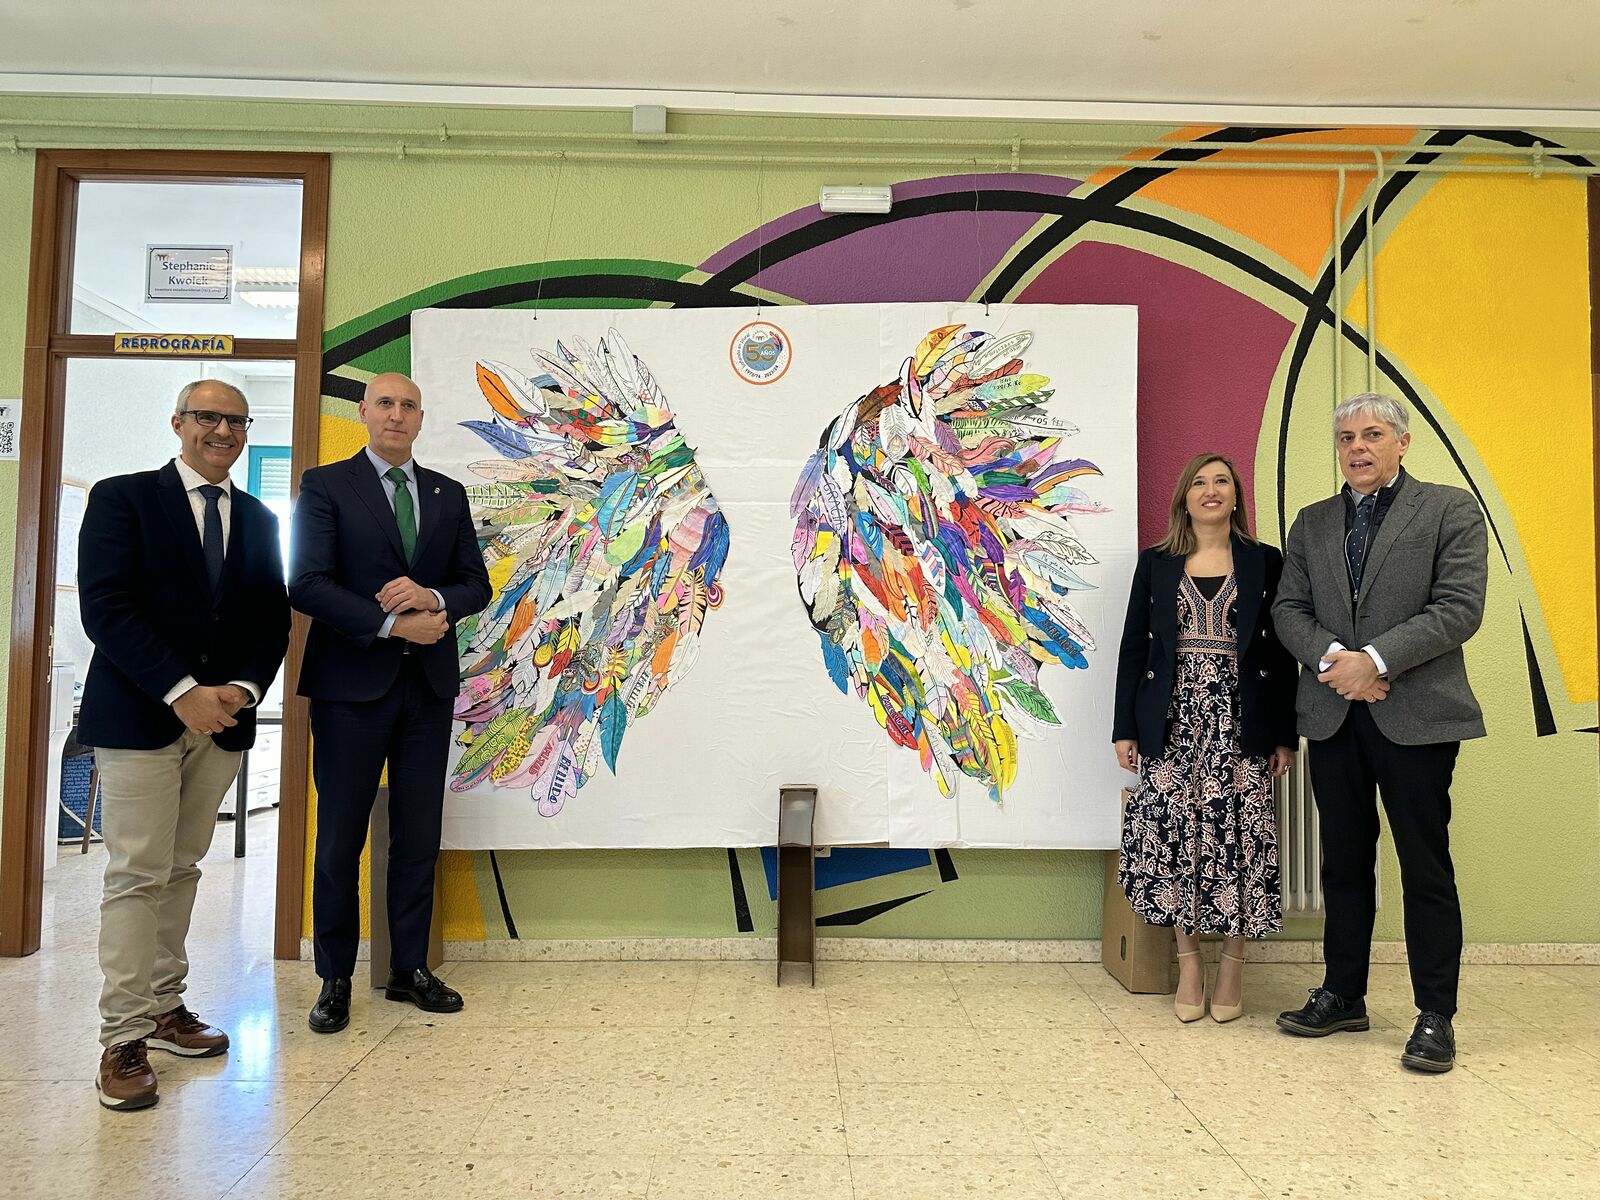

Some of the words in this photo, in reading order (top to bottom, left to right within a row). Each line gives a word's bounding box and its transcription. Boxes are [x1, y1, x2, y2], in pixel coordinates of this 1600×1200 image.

[162, 261, 216, 272] Stephanie
[168, 276, 208, 285] Kwolek
[121, 336, 225, 351] REPROGRAFÍA
[745, 344, 775, 363] 50
[823, 482, 844, 530] GRACIAS
[550, 754, 571, 804] BELLIDO
